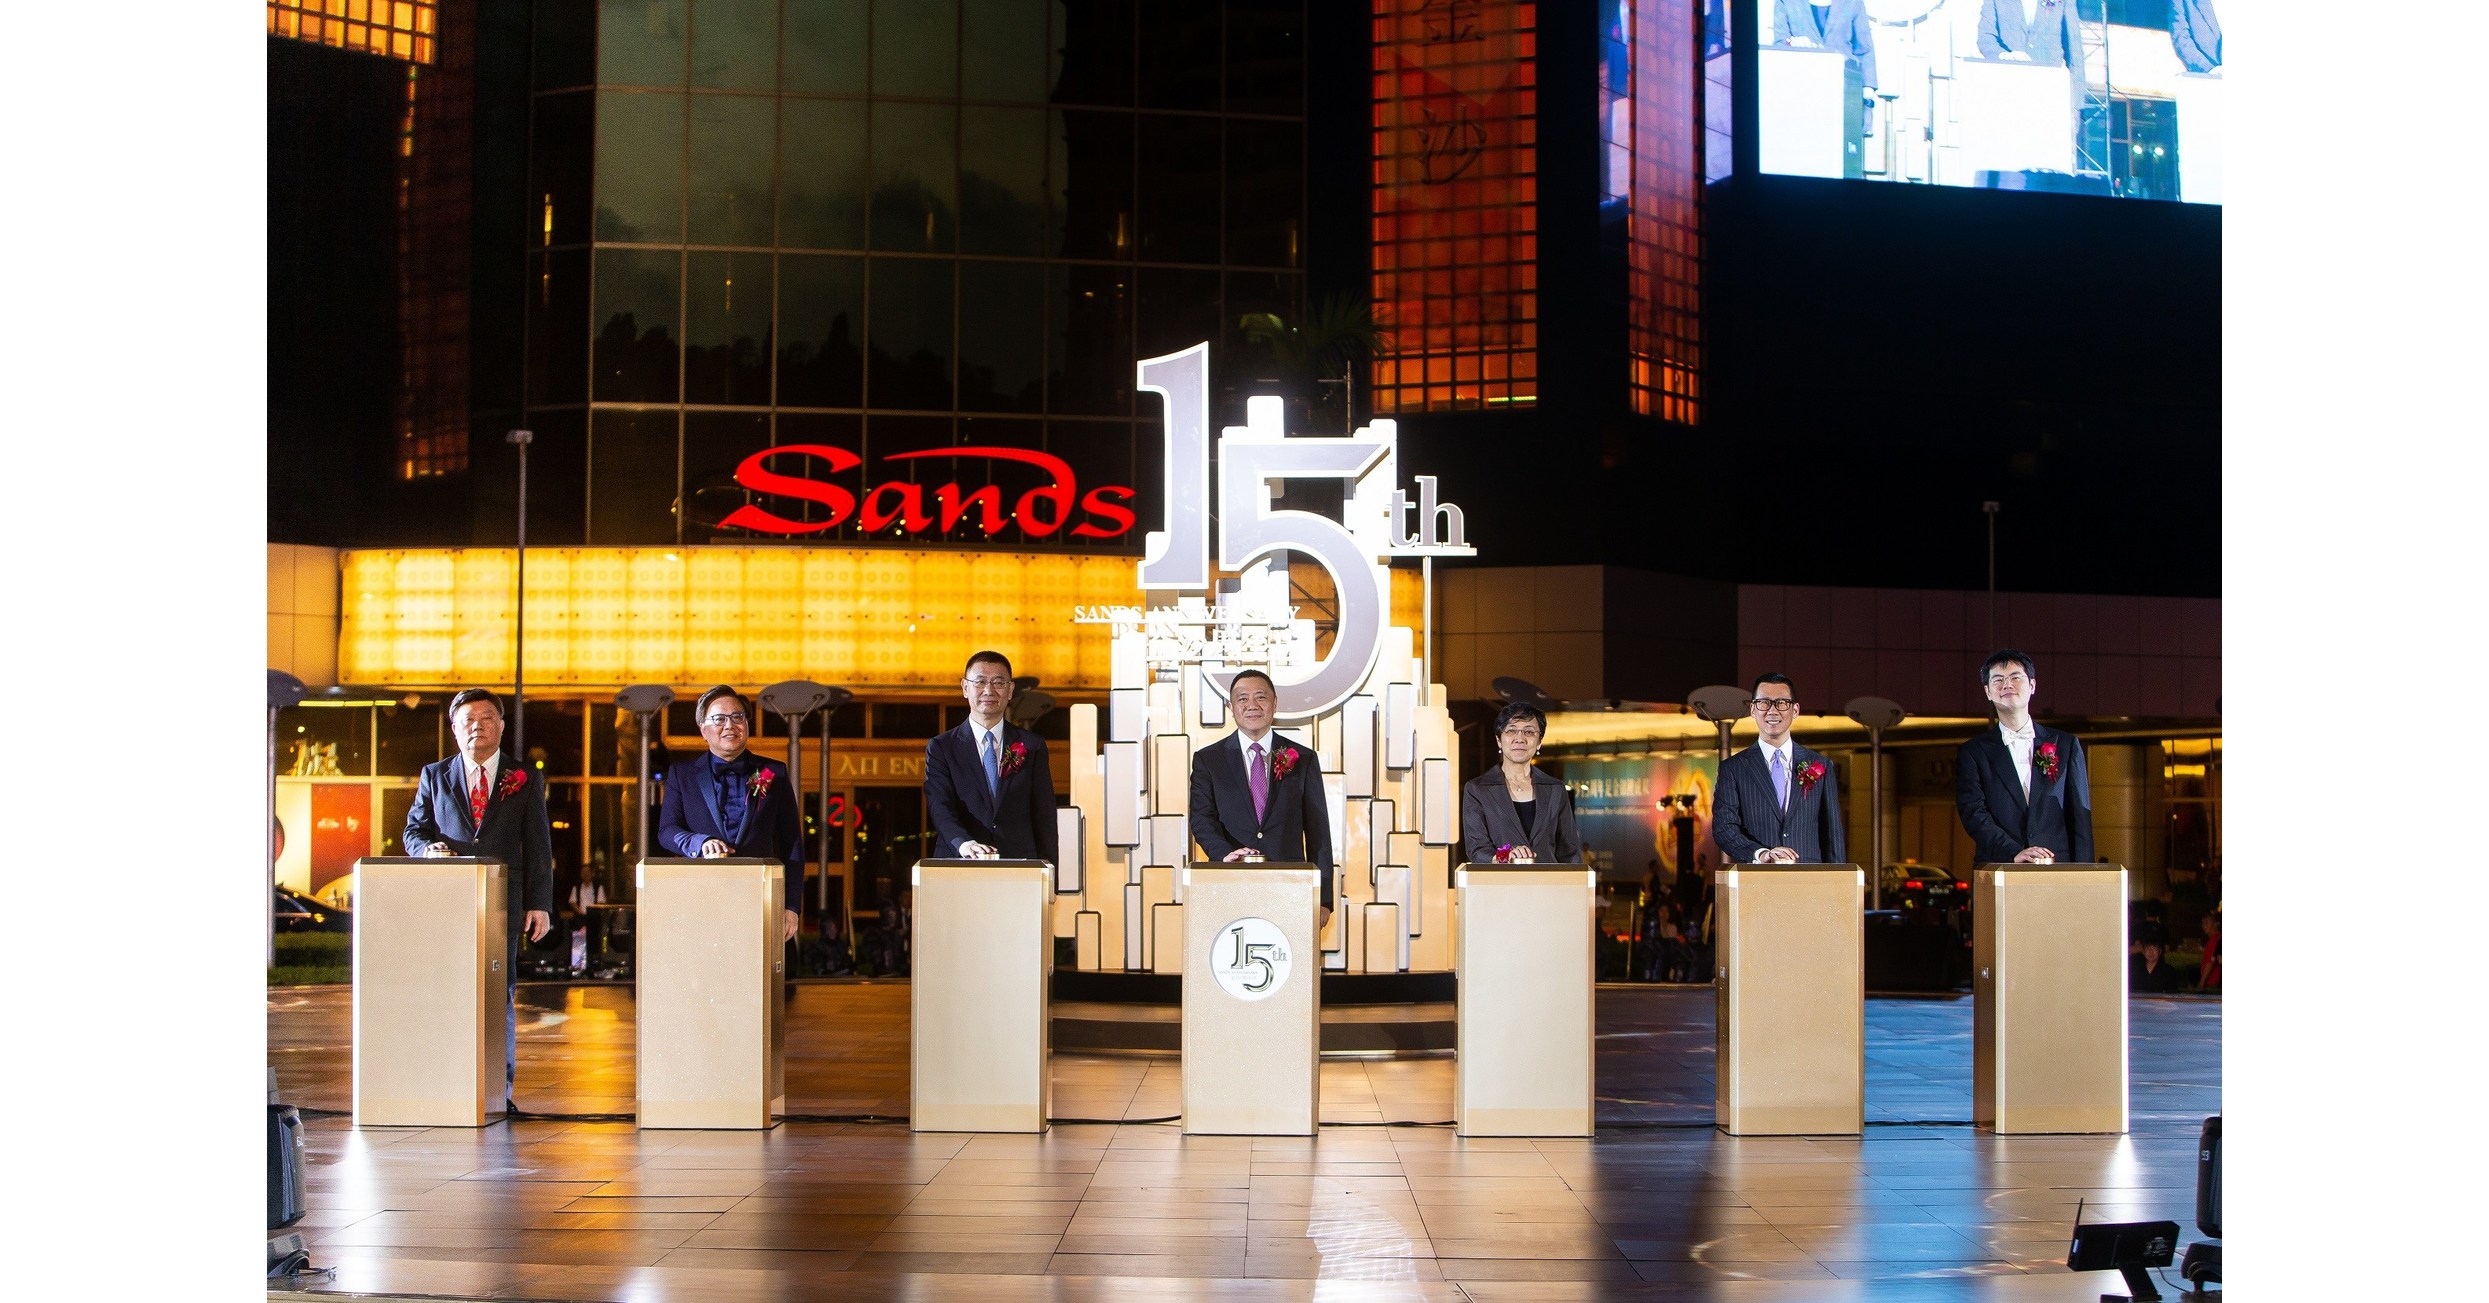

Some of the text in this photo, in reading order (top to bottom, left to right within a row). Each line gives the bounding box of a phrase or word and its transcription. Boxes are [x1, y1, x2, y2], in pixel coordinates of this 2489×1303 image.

[716, 444, 1137, 538] Sands
[1137, 340, 1474, 720] 15th
[1074, 605, 1300, 620] SANDS ANNVESAY
